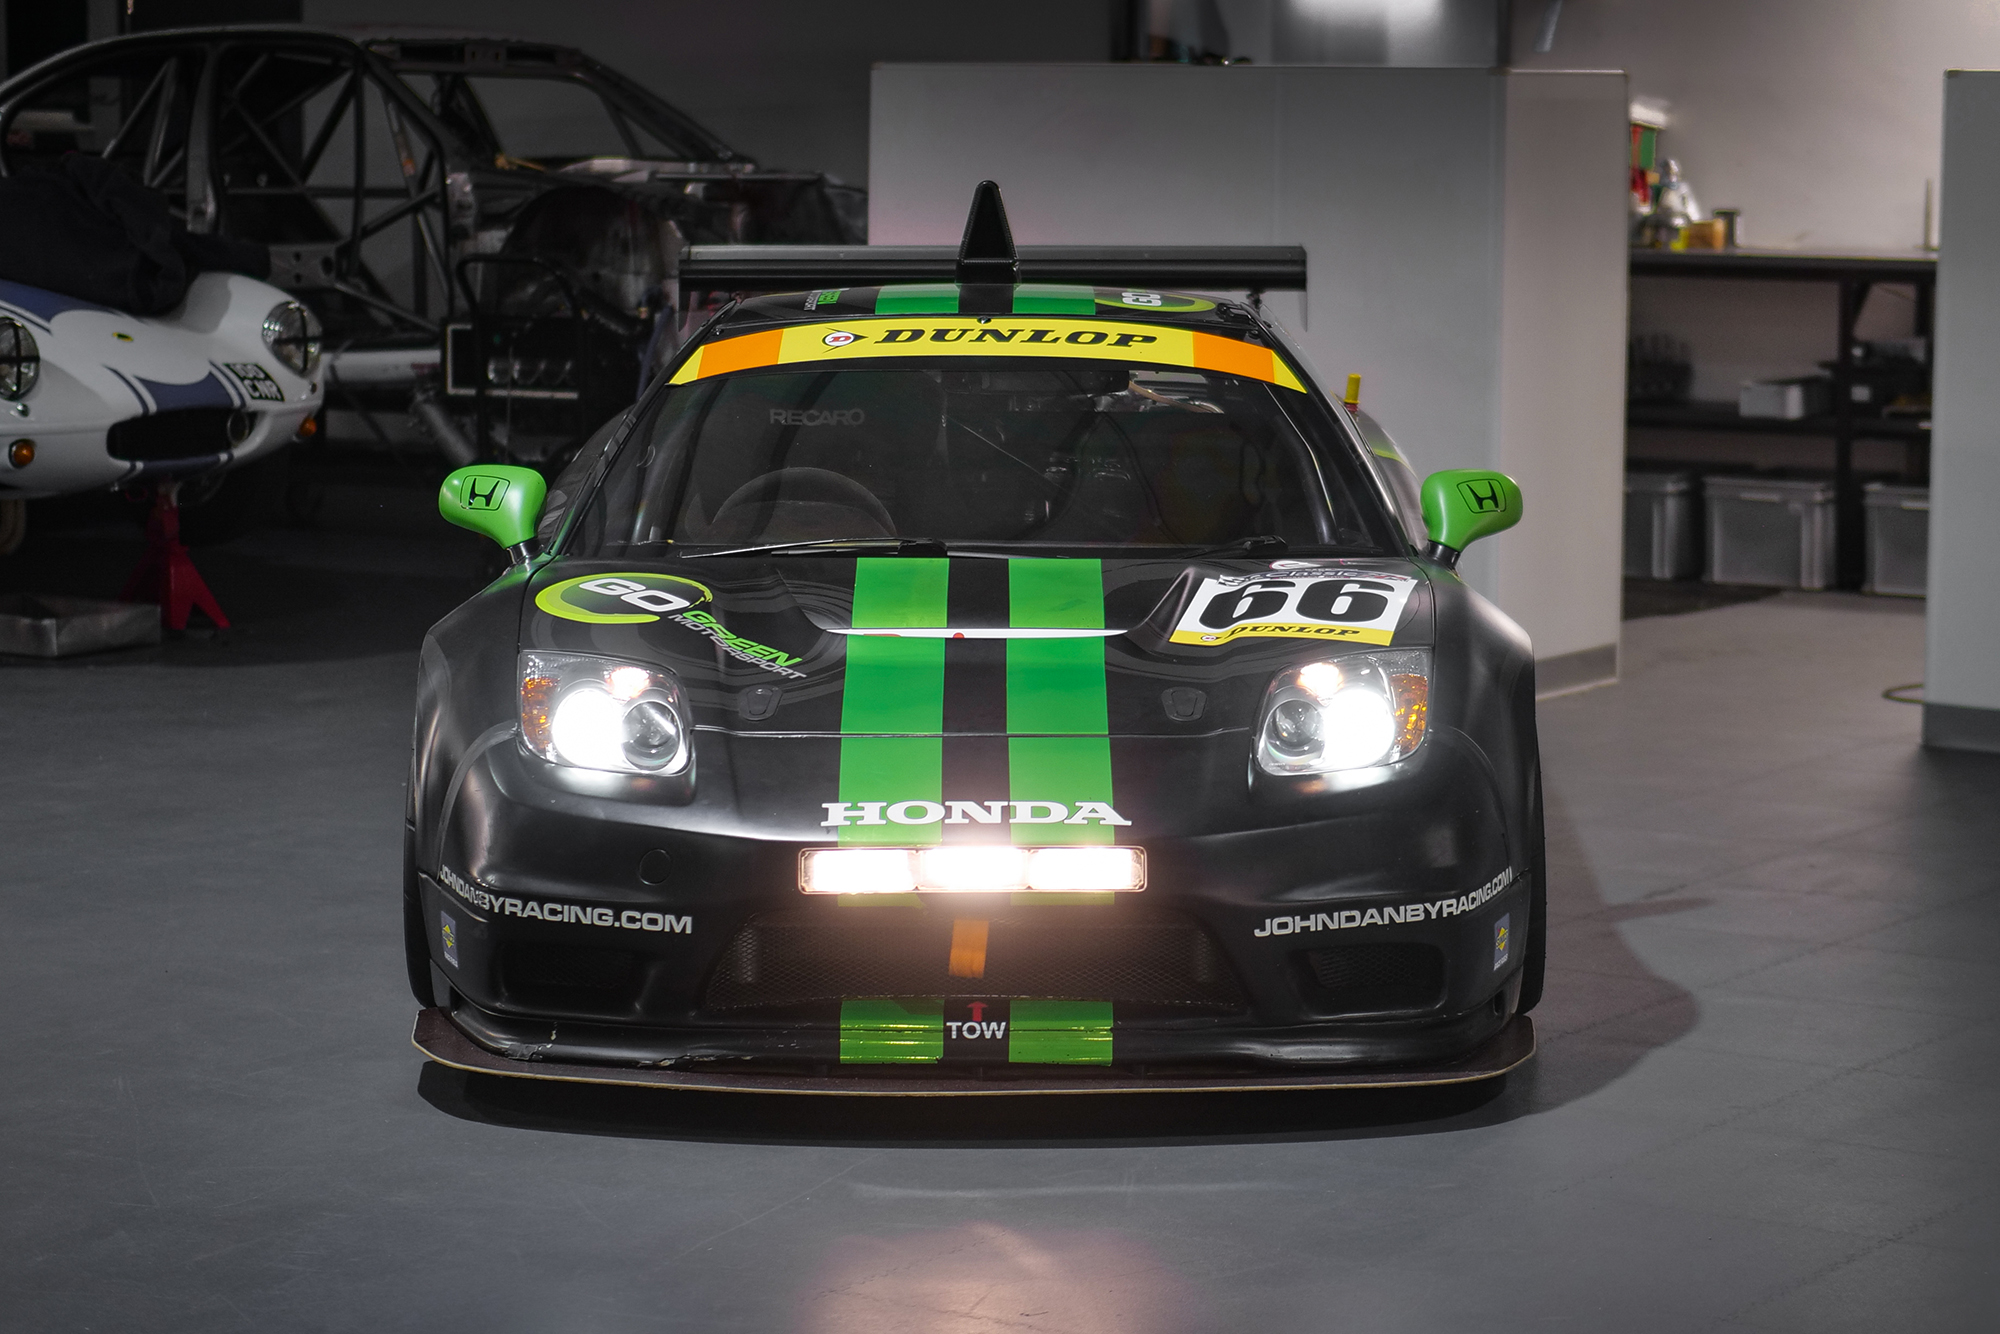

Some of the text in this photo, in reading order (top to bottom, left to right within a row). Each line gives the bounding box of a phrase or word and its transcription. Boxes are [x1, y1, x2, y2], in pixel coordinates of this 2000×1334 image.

[874, 329, 1158, 348] DUNLOP
[769, 408, 865, 426] RECARO
[578, 578, 691, 612] GO
[1198, 579, 1395, 629] 66
[667, 614, 807, 679] MOTORSPORT
[682, 610, 803, 667] GREEN
[1226, 625, 1360, 638] DUNLOP
[820, 800, 1133, 826] HONDA
[440, 864, 693, 934] JOHNDANBYRACING.COM
[1253, 865, 1513, 938] JOHNDANBYRACING.COM
[946, 1021, 1007, 1039] TOW
